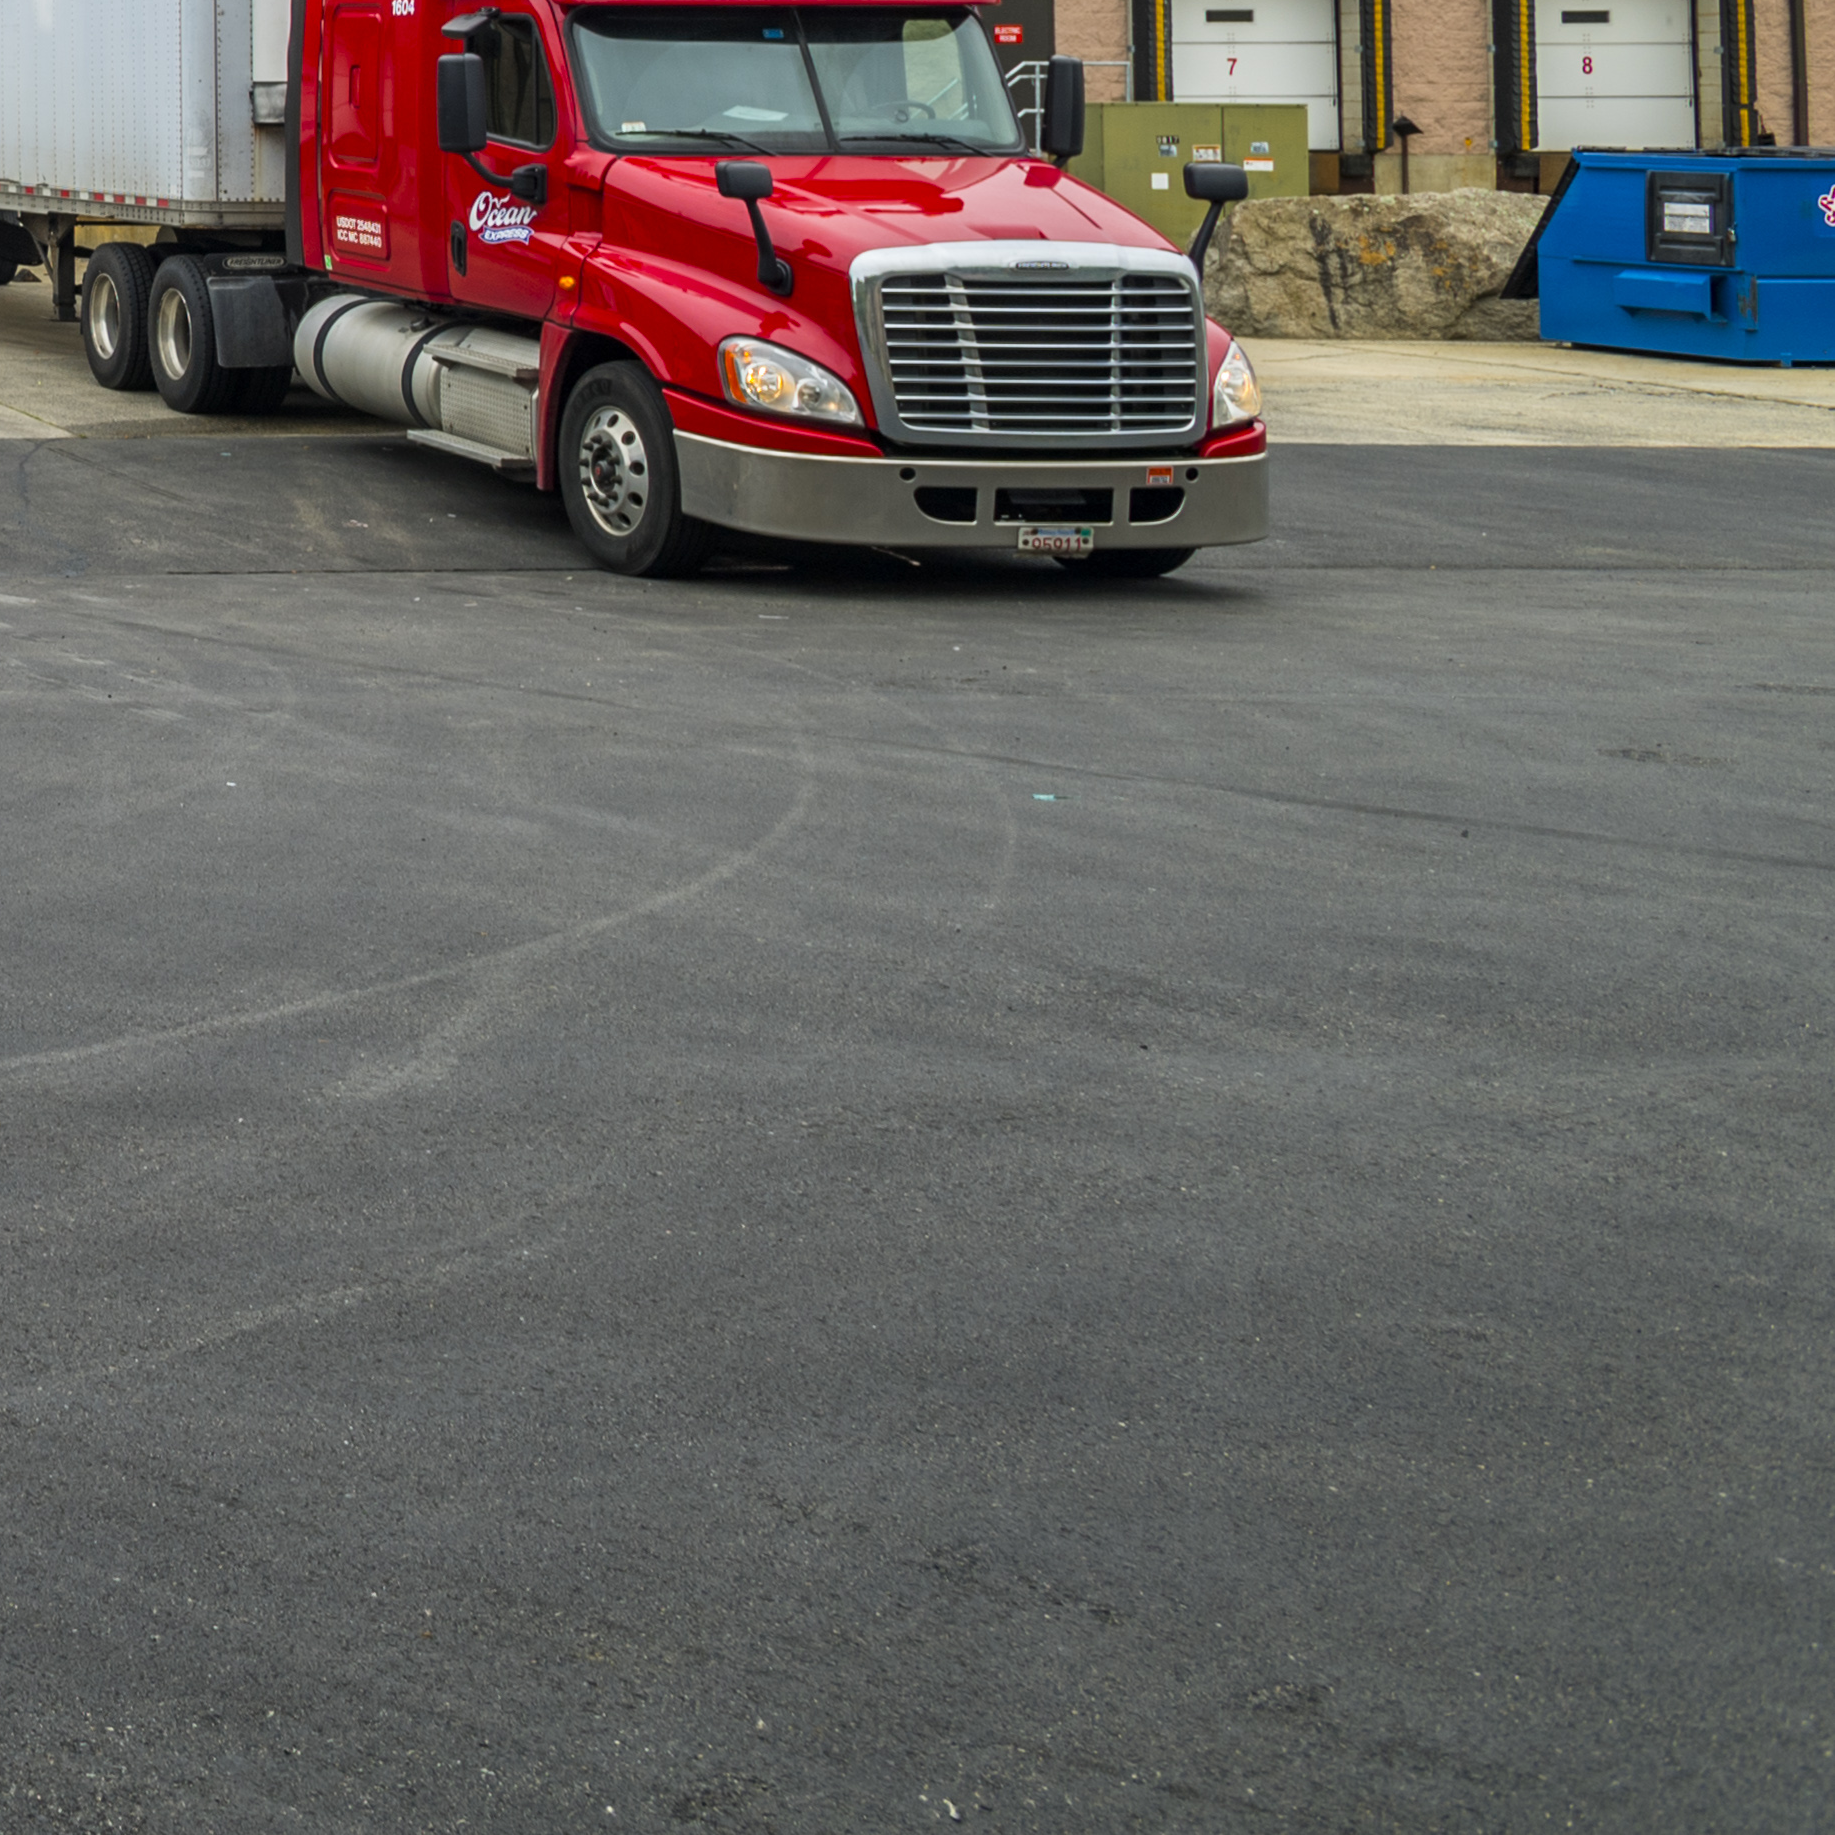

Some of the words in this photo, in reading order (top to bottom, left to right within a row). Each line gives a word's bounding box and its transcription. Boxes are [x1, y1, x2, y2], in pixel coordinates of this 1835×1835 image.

[995, 26, 1021, 34] ELECTRIC
[1227, 58, 1238, 76] 7
[1582, 56, 1593, 75] 8
[469, 191, 537, 232] Ocean
[336, 216, 356, 230] USDOT
[484, 228, 529, 241] EXPRESS
